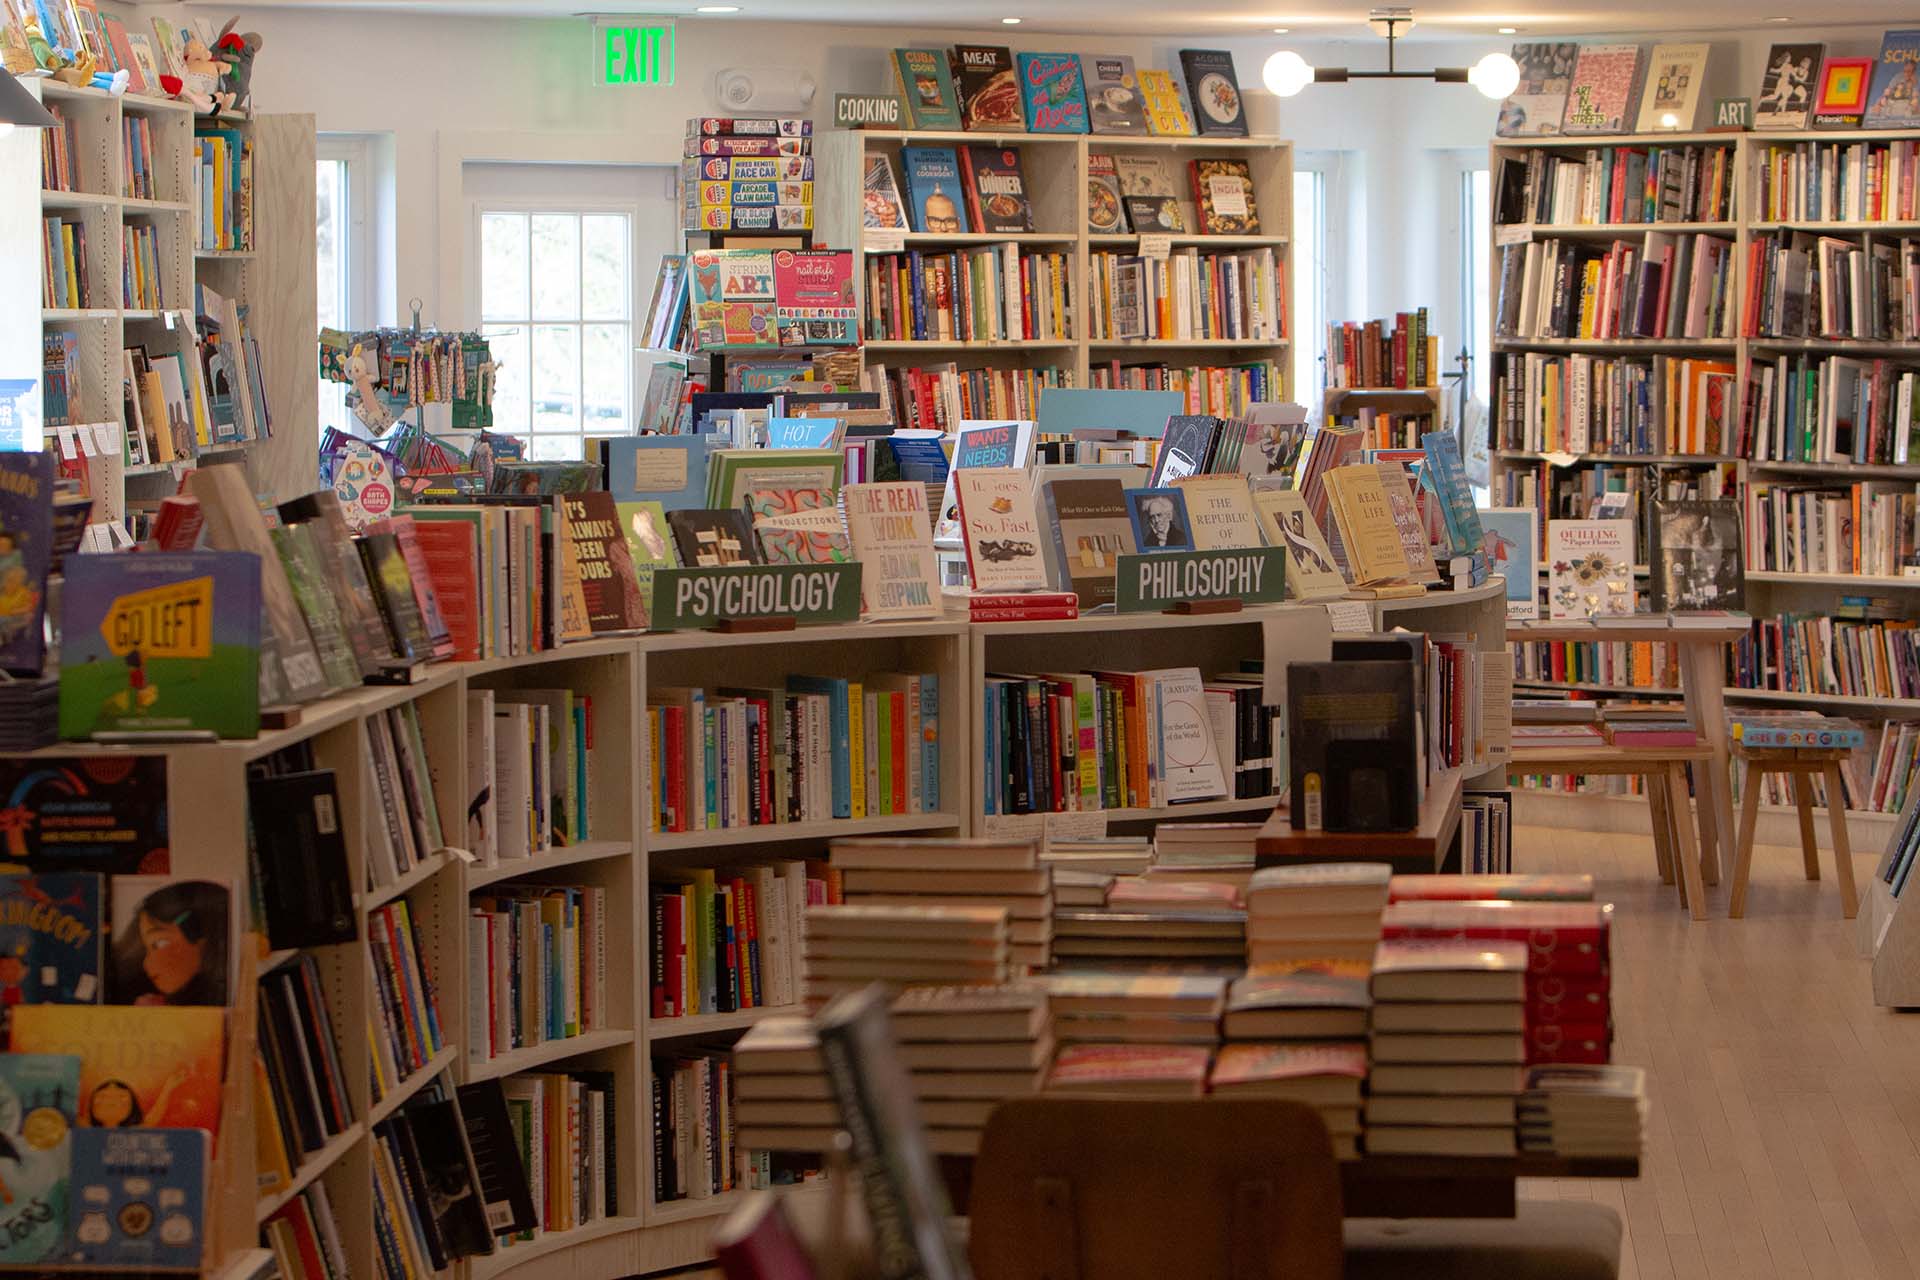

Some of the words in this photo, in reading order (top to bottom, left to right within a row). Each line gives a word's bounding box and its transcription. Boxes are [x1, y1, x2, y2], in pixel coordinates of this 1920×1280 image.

[605, 28, 664, 84] EXIT
[905, 52, 936, 63] CUBA
[963, 52, 997, 65] MEAT
[953, 75, 964, 113] MEAT
[1576, 86, 1592, 95] ART
[1579, 95, 1588, 104] IN
[838, 98, 898, 122] COOKING
[1579, 104, 1593, 114] THE
[1718, 102, 1746, 125] ART
[1570, 113, 1605, 125] STREETS
[1816, 115, 1842, 123] Polaroid
[734, 168, 757, 178] RACE
[759, 167, 777, 178] CAR
[741, 184, 768, 193] ARCADE
[979, 175, 1022, 195] DINNER
[1213, 185, 1241, 195] INDIA
[735, 193, 755, 202] CLAW
[755, 193, 775, 201] GAME
[734, 209, 748, 218] AIR
[750, 208, 774, 217] BLAST
[738, 218, 769, 227] CANNON
[728, 265, 769, 275] STRING
[725, 275, 772, 295] ART
[783, 425, 815, 441] HOT
[967, 428, 1009, 448] WANTS
[965, 448, 1007, 467] NEEDS
[855, 488, 883, 514] THE
[887, 487, 924, 513] REAL
[1208, 498, 1232, 509] THE
[1357, 492, 1383, 504] REAL
[567, 500, 587, 519] T'S
[1363, 507, 1385, 520] LIFE
[772, 516, 838, 526] PROJECTIONS
[1196, 513, 1249, 525] REPUBLIC
[871, 516, 917, 541] WORK
[1219, 529, 1233, 539] OF
[1560, 529, 1616, 542] QUILLING
[574, 541, 606, 559] BEEN
[880, 554, 921, 579] ADAM
[1139, 556, 1265, 600] PHILOSOPHY
[676, 572, 840, 617] PSYCHOLOGY
[879, 582, 931, 607] GOPNIK
[114, 610, 144, 648] GO
[151, 598, 201, 649] LEFT
[1164, 685, 1198, 695] GRAYLING
[810, 738, 818, 765] Happy
